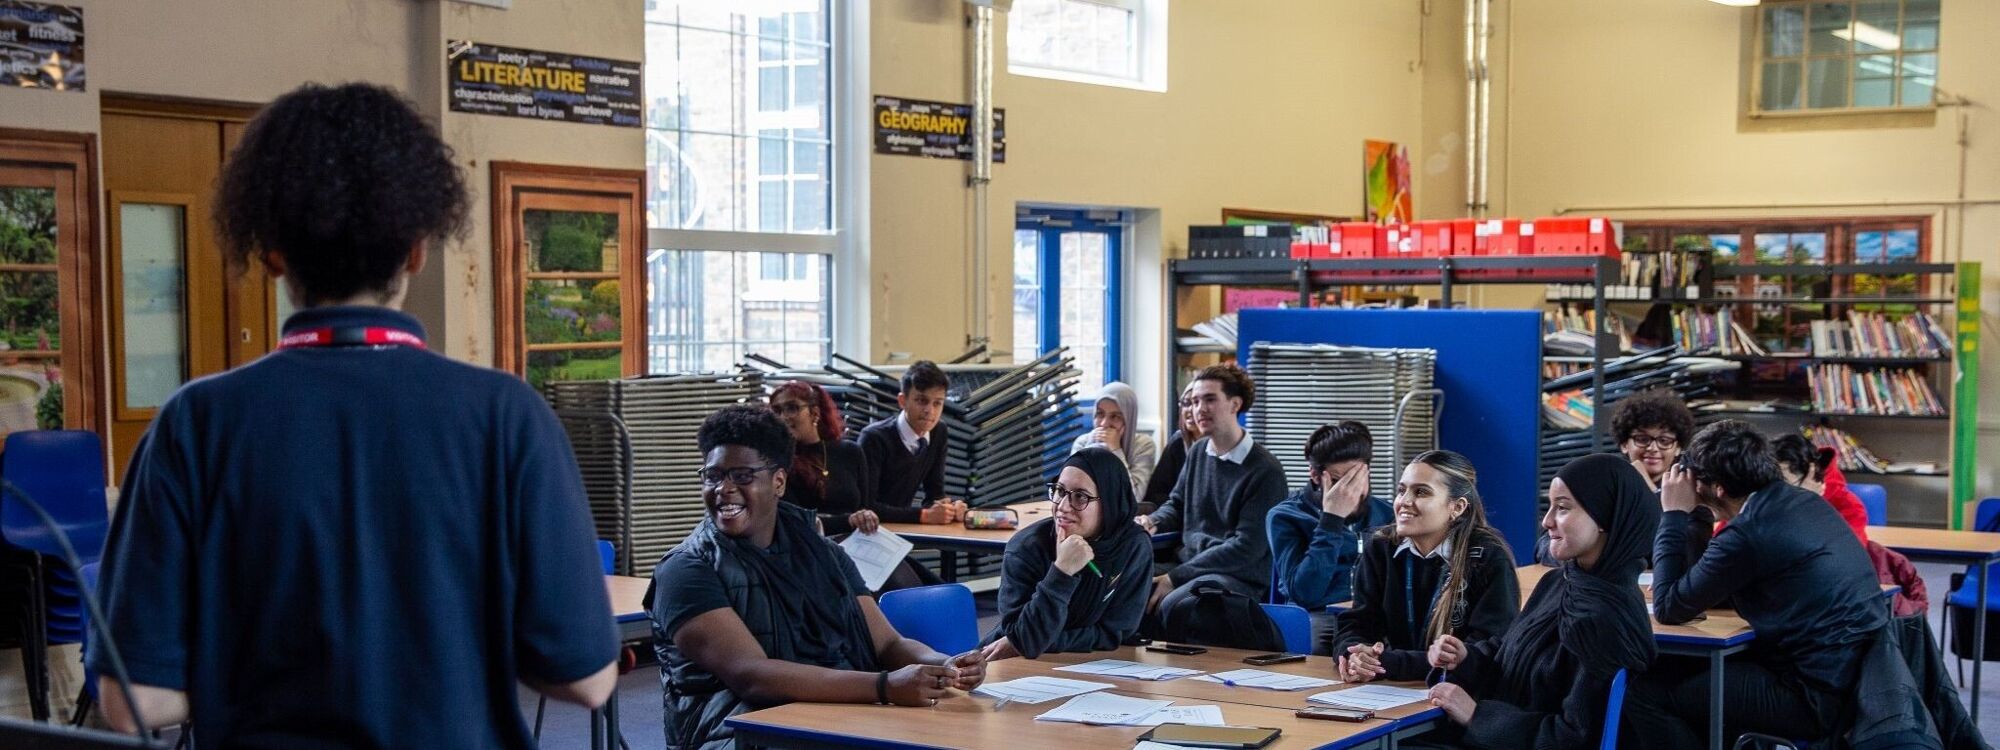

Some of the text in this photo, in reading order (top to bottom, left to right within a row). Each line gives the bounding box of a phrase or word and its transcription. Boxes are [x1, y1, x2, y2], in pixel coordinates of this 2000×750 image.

[29, 25, 76, 42] fitness
[498, 53, 528, 67] poetry
[461, 60, 585, 93] LITERATURE
[589, 74, 630, 87] narrative
[455, 88, 533, 104] characterisation
[538, 106, 565, 119] byron
[572, 104, 612, 118] marlowe
[880, 111, 966, 134] GEOGRAPHY
